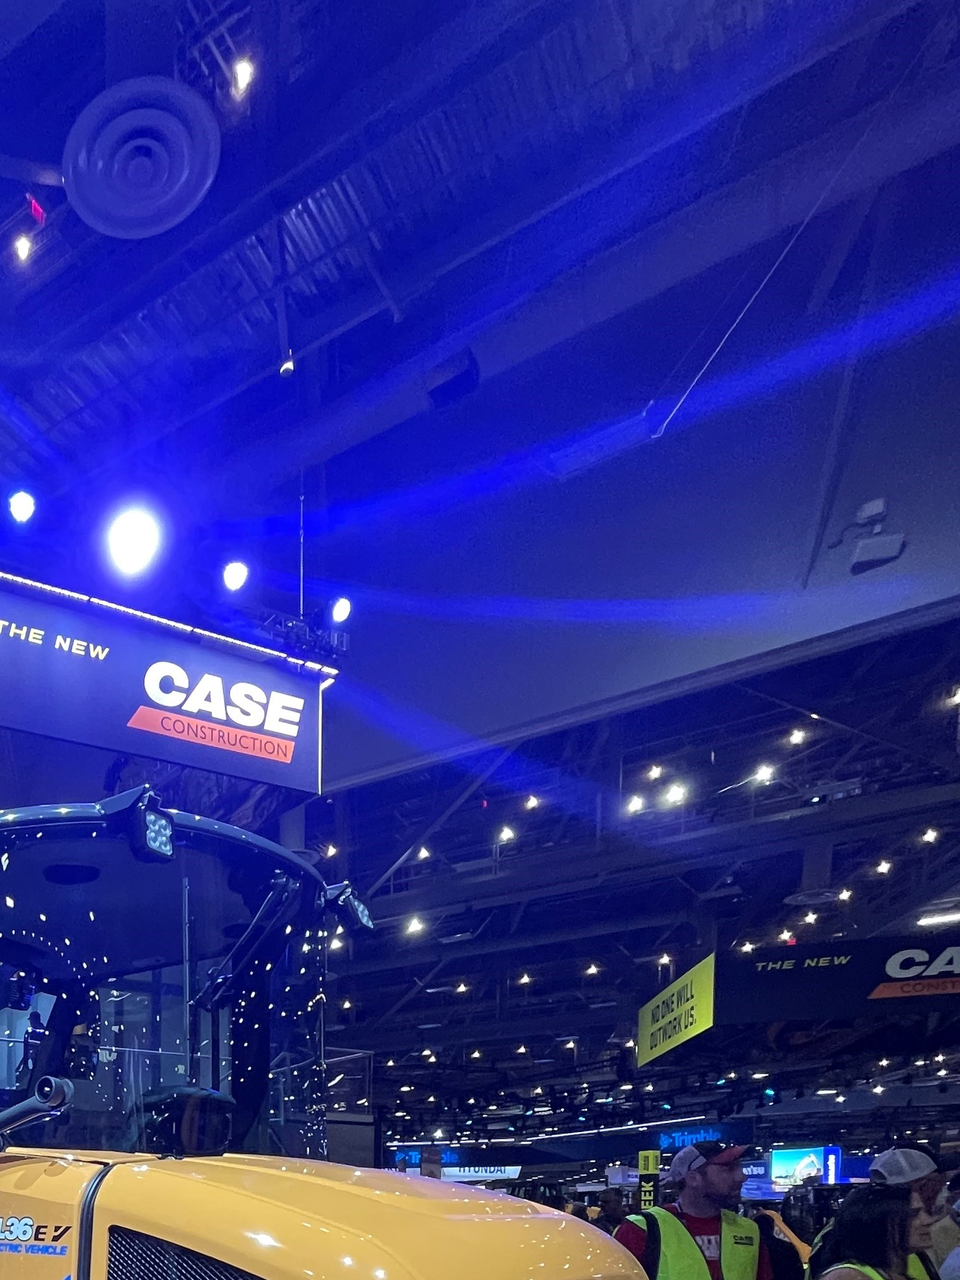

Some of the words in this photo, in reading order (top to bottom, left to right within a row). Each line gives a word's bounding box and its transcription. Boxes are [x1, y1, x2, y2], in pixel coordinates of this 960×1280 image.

[54, 633, 110, 661] NEW
[143, 660, 306, 738] CASE
[160, 715, 289, 759] CONSTRUCTION
[755, 959, 795, 972] THE
[803, 955, 853, 969] NEW
[650, 1004, 660, 1027] NO
[661, 991, 675, 1020] ONE
[676, 978, 695, 1010] WILL
[649, 1012, 683, 1051] OUTWORK
[24, 1244, 69, 1256] VEHICLE
